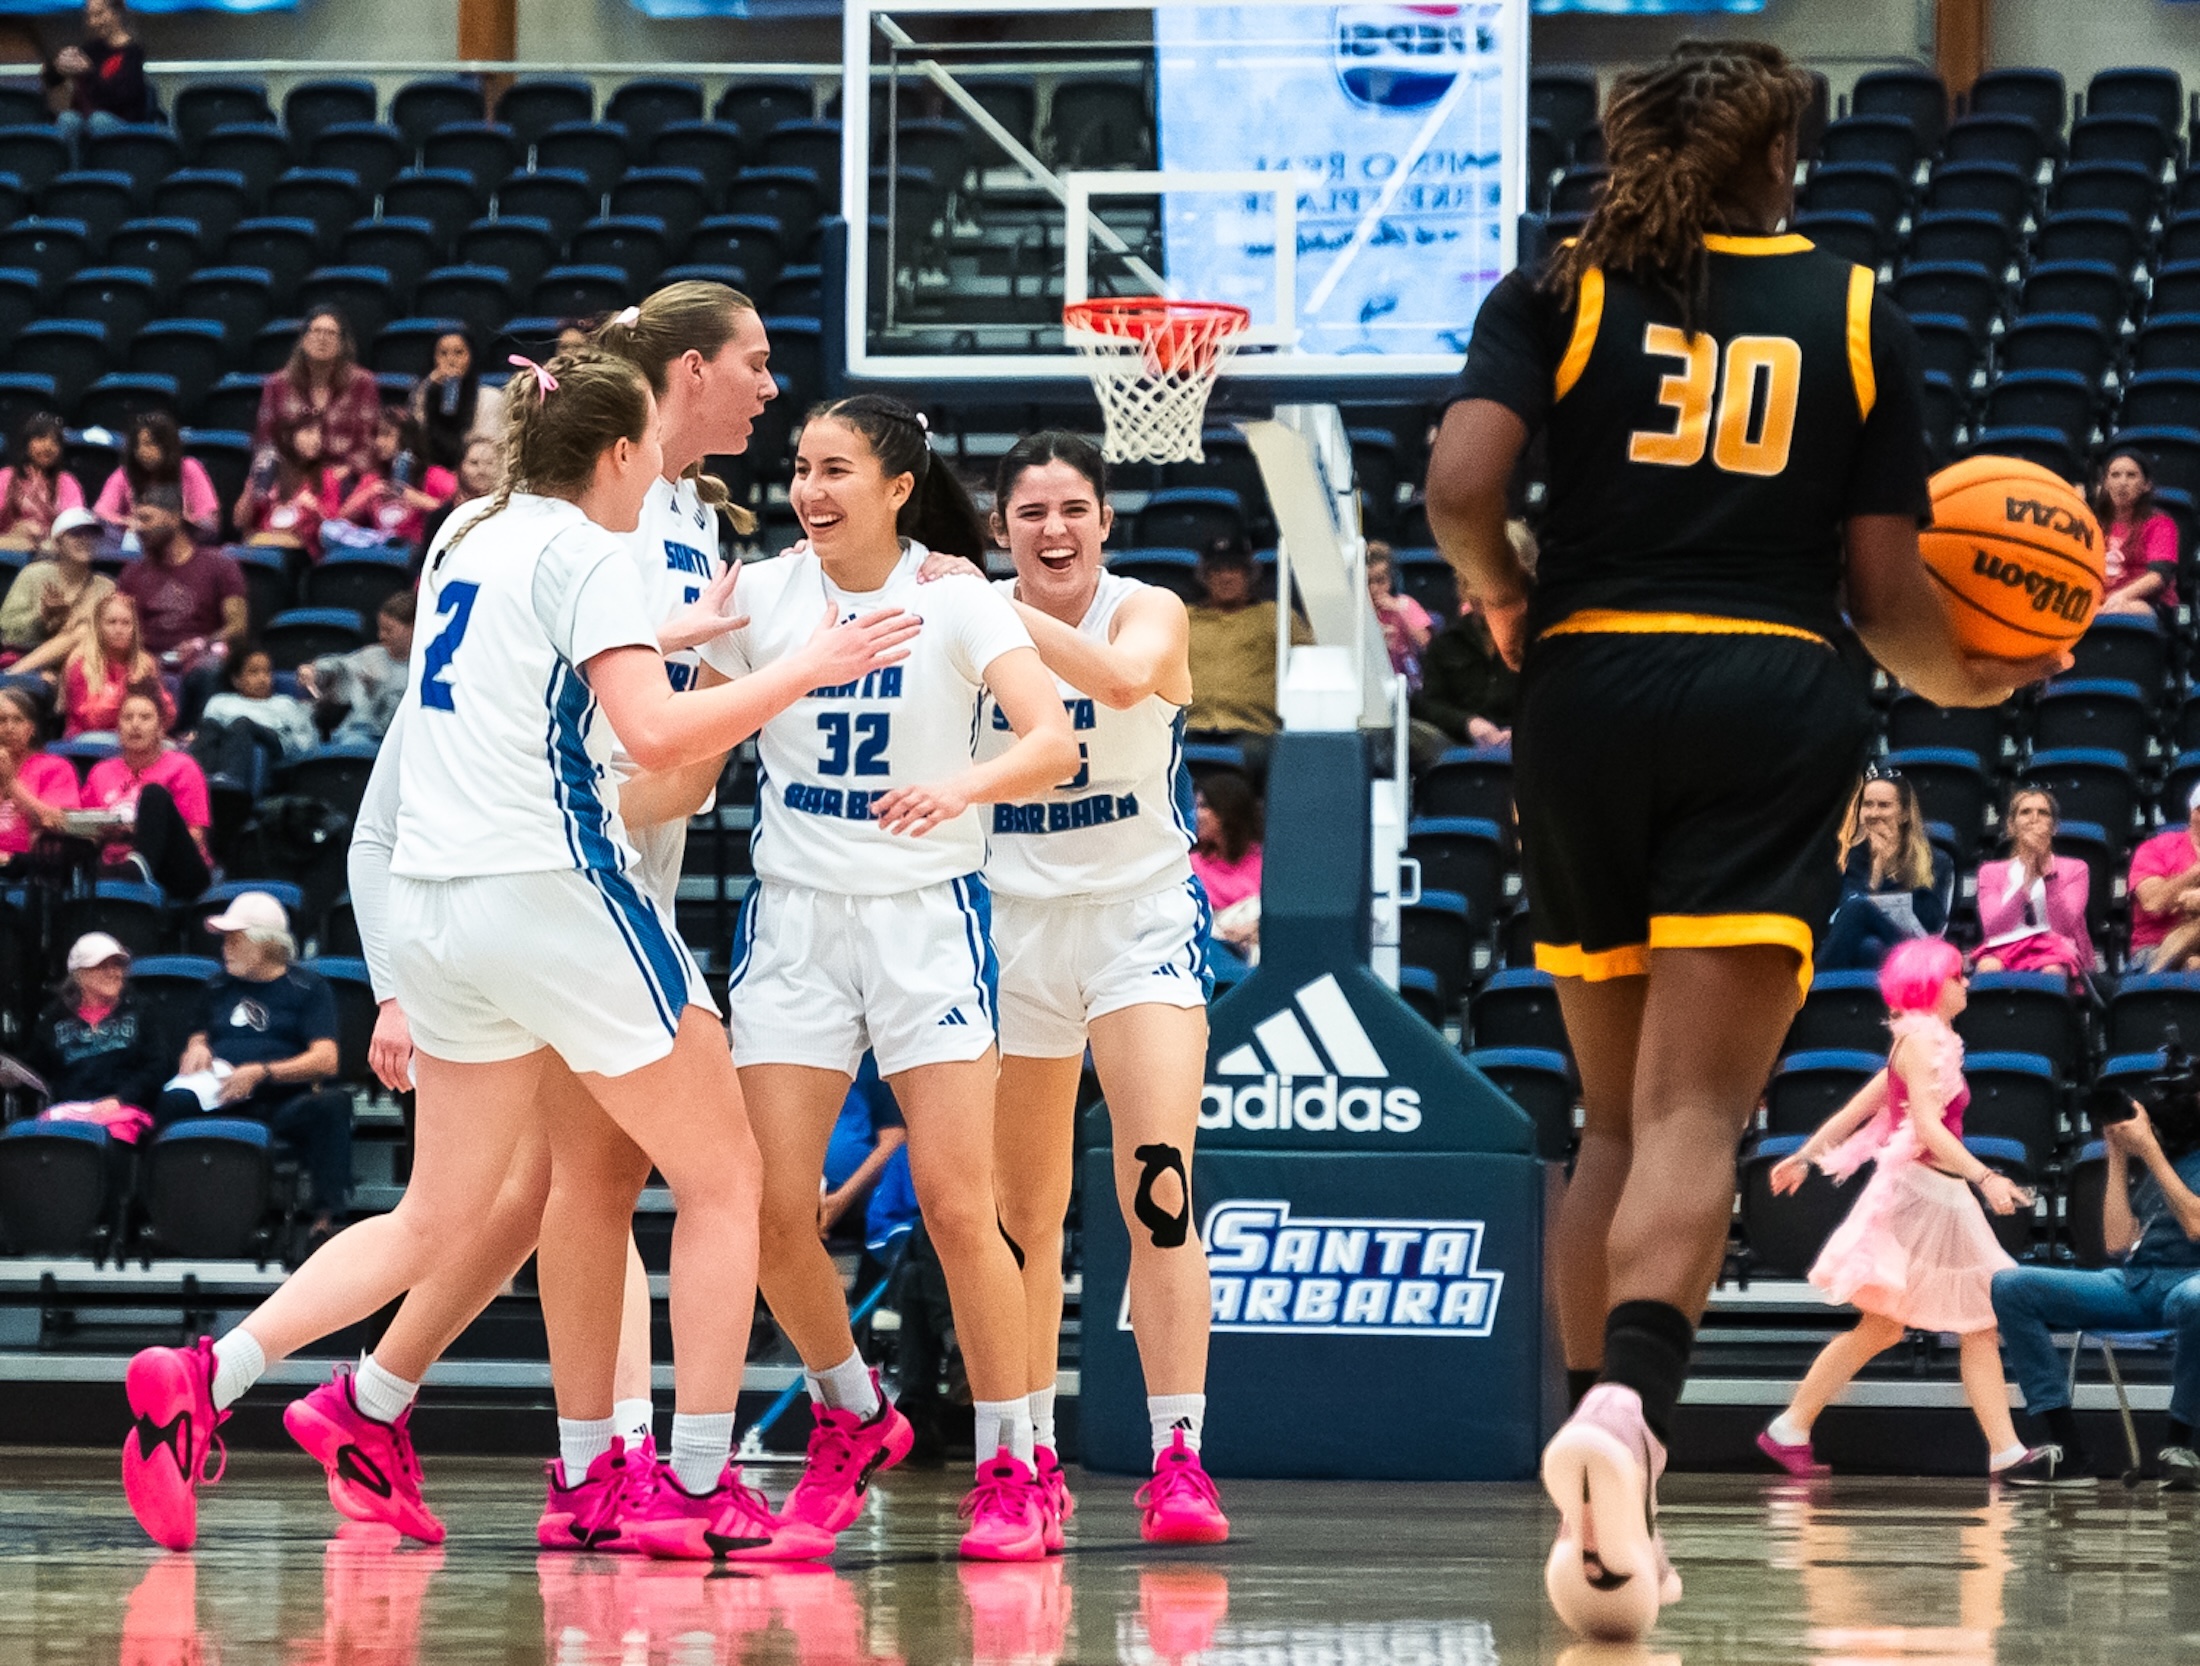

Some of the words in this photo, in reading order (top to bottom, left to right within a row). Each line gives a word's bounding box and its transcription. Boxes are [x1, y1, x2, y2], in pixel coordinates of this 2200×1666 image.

[1629, 322, 1802, 476] 30
[2006, 497, 2094, 550] NCAA
[1973, 549, 2093, 624] Wilson
[421, 579, 481, 713] 2
[817, 711, 890, 776] 32
[993, 792, 1139, 833] BARBARA
[1198, 1073, 1422, 1132] adidas
[1209, 1278, 1490, 1326] ARBARA
